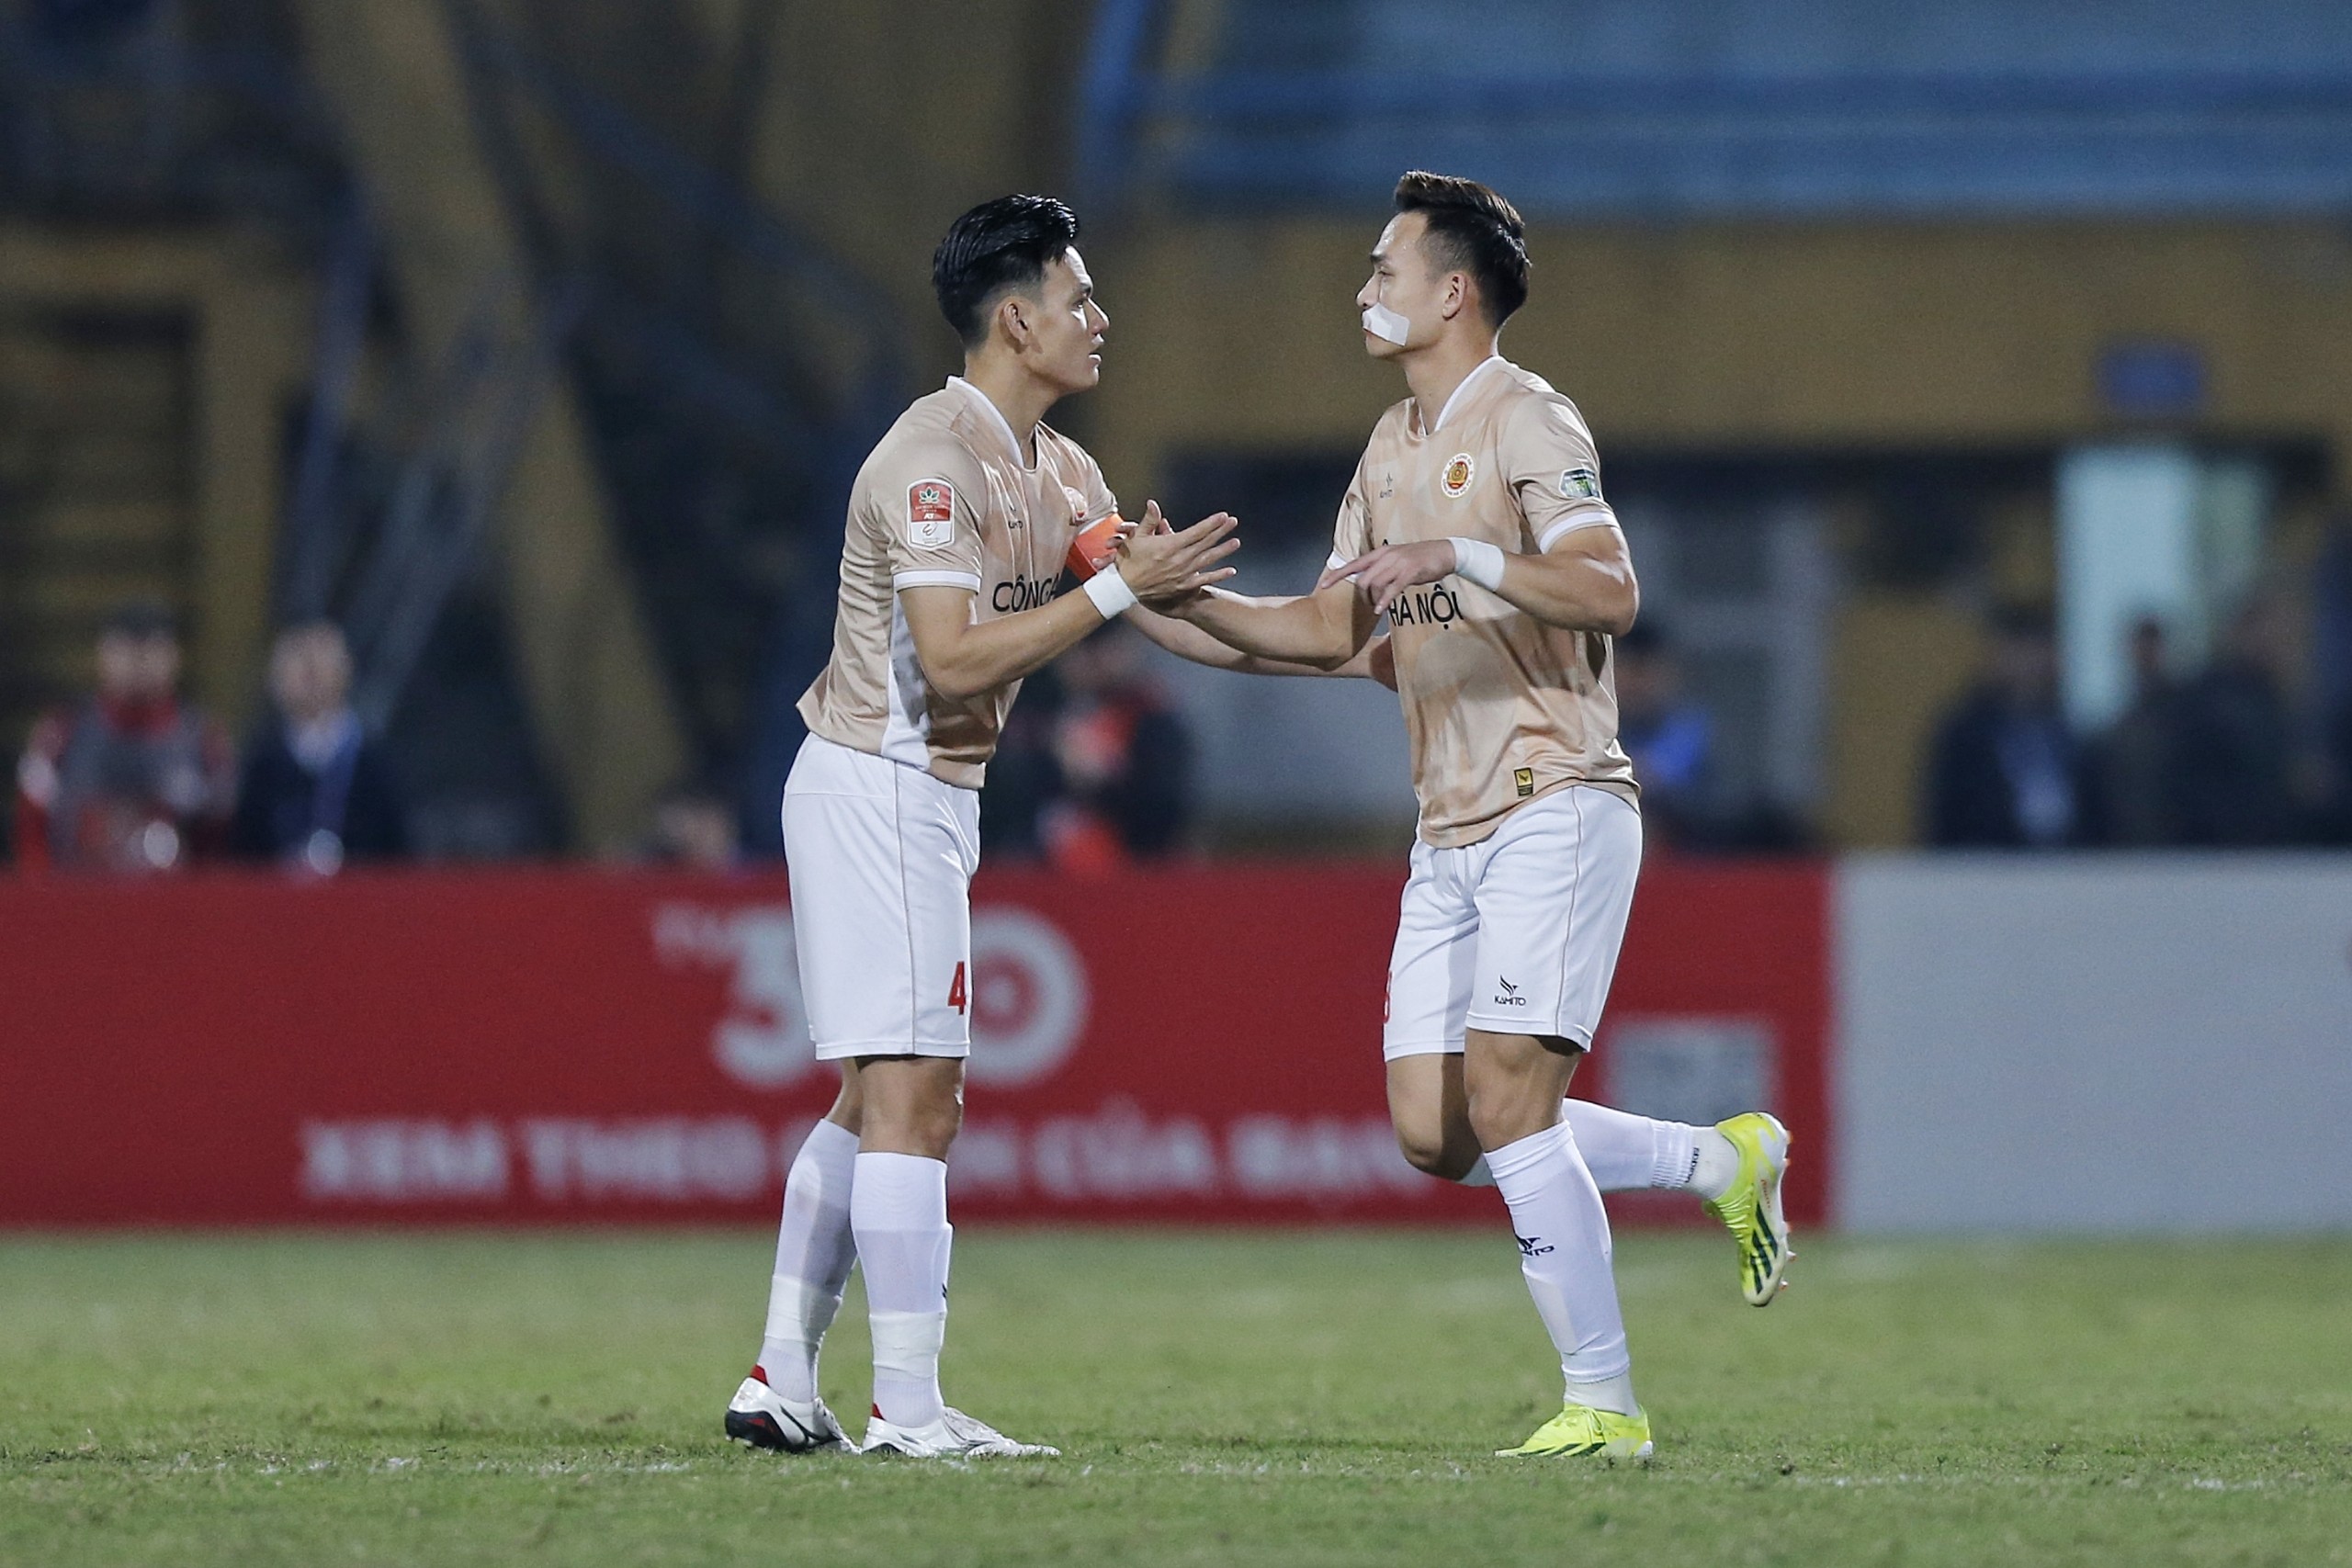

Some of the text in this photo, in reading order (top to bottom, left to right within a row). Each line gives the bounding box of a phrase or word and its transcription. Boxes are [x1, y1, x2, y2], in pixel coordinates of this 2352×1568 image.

[1416, 583, 1464, 630] NỘI
[947, 961, 967, 1015] 4
[1494, 994, 1527, 1007] KAMITO
